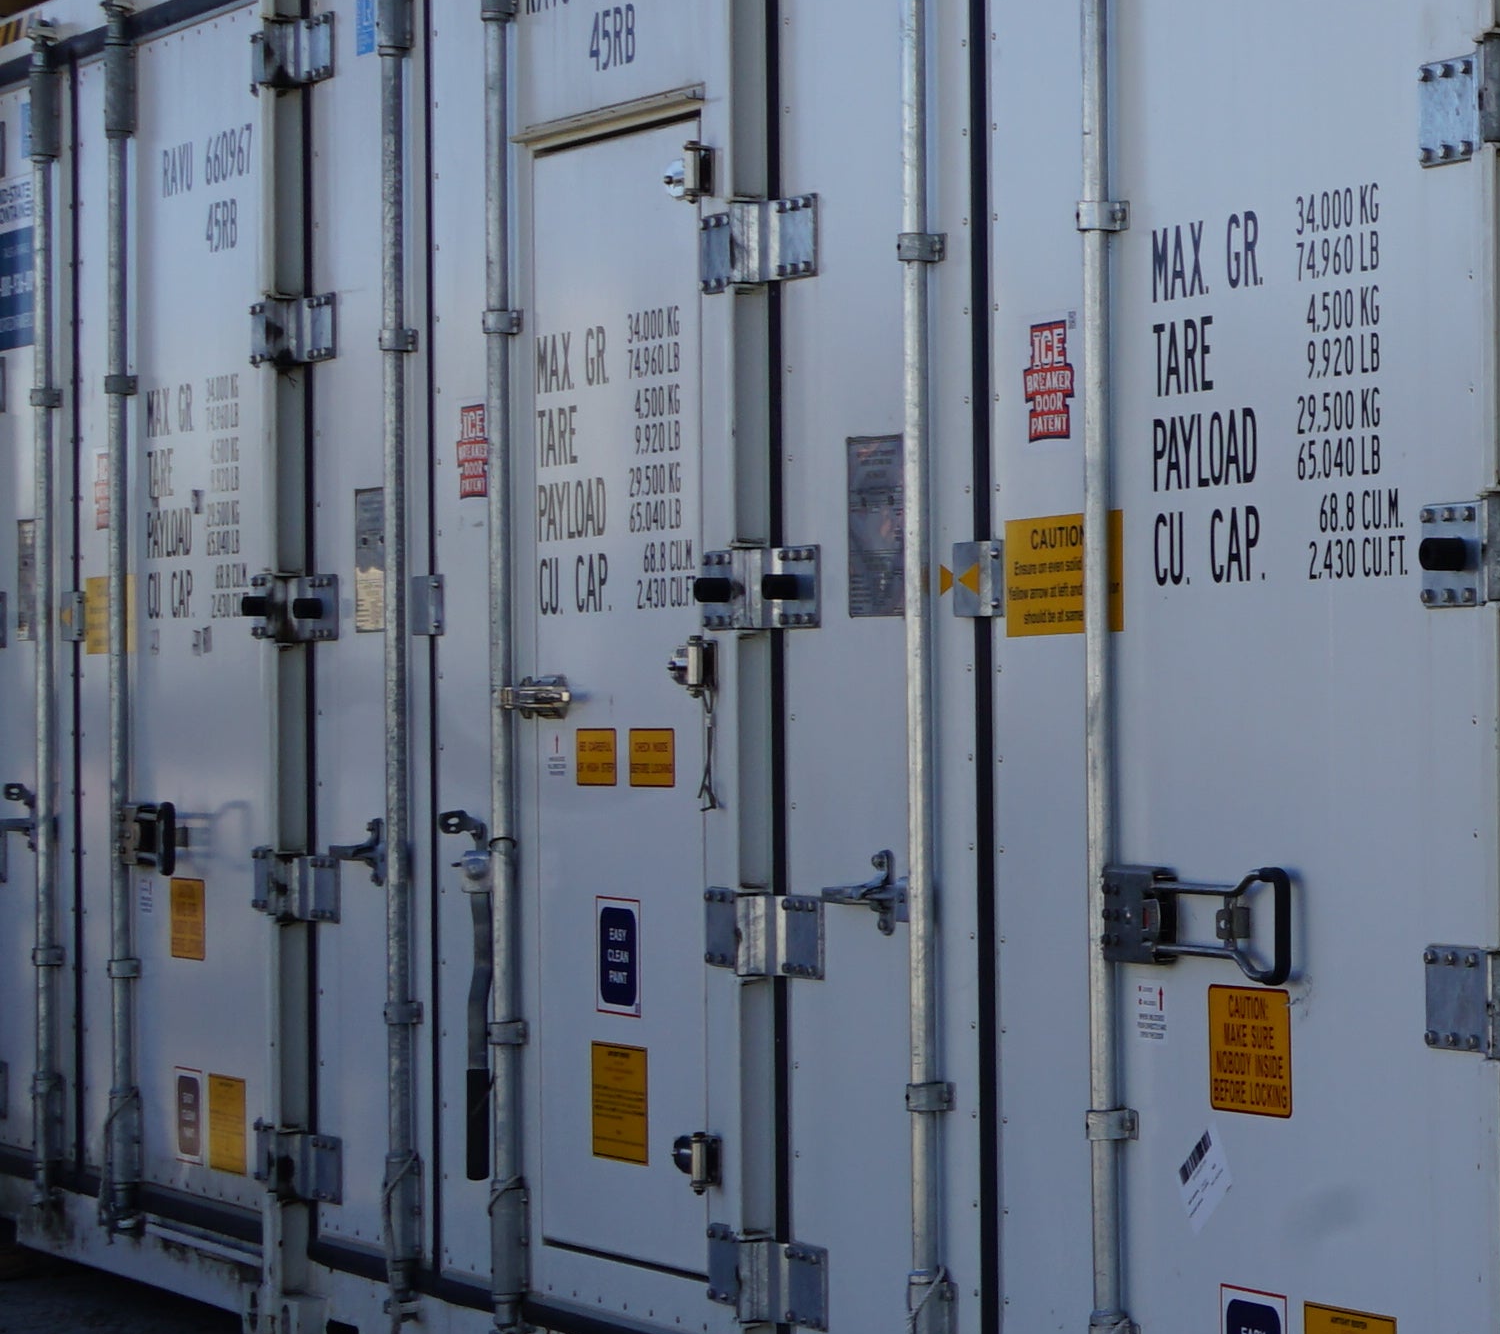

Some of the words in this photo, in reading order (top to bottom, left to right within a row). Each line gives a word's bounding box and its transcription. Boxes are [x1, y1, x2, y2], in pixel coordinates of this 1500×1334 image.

[589, 3, 636, 72] 45RB
[163, 141, 193, 198] RAVU
[205, 123, 252, 186] 660967
[206, 198, 238, 253] 45RB
[1296, 187, 1353, 236] 34,000
[1360, 182, 1380, 225] KG
[1152, 220, 1209, 304] MAX.
[1226, 210, 1263, 289] GR.
[1296, 234, 1354, 282] 74,960
[1360, 230, 1379, 272] LB
[667, 305, 680, 338] KG
[1307, 288, 1354, 334] 4,500
[1360, 285, 1380, 327] KG
[536, 331, 575, 394] MAX.
[585, 325, 610, 386] GR.
[667, 341, 680, 373] LB
[1032, 328, 1065, 369] ICE
[1152, 315, 1213, 397] TARE
[1307, 335, 1354, 379] 9,920
[1360, 332, 1380, 374] LB
[1026, 370, 1072, 394] BREAKER
[1035, 391, 1063, 413] DOOR
[1031, 414, 1068, 435] PATENT
[1297, 390, 1354, 435] 29,500
[1361, 387, 1381, 429] KG
[537, 405, 578, 468] TARE
[1153, 406, 1257, 493] PAYLOAD
[1297, 436, 1355, 481] 65,040
[1361, 434, 1381, 476] LB
[668, 461, 682, 494] KG
[537, 476, 606, 543] PAYLOAD
[669, 498, 682, 529] LB
[1319, 491, 1355, 533] 68.8
[1362, 488, 1403, 530] CU.M.
[643, 541, 666, 573] 68.8
[1154, 511, 1190, 587] CU.
[1210, 504, 1266, 584] CAP.
[1308, 538, 1356, 580] 2,430
[1362, 535, 1408, 577] CU.FT.
[539, 556, 563, 616] CU.
[575, 553, 612, 613] CAP.
[607, 949, 629, 964] CLEAN
[609, 927, 628, 942] EASY
[608, 969, 628, 984] PAINT
[1228, 994, 1269, 1020] CAUTION:
[1224, 1022, 1247, 1048] MAKE
[1251, 1024, 1275, 1050] SURE
[1216, 1050, 1251, 1076] NOBODY
[1255, 1054, 1284, 1080] INSIDE
[1214, 1077, 1247, 1104] BEFORE
[1250, 1082, 1287, 1109] LOCKING
